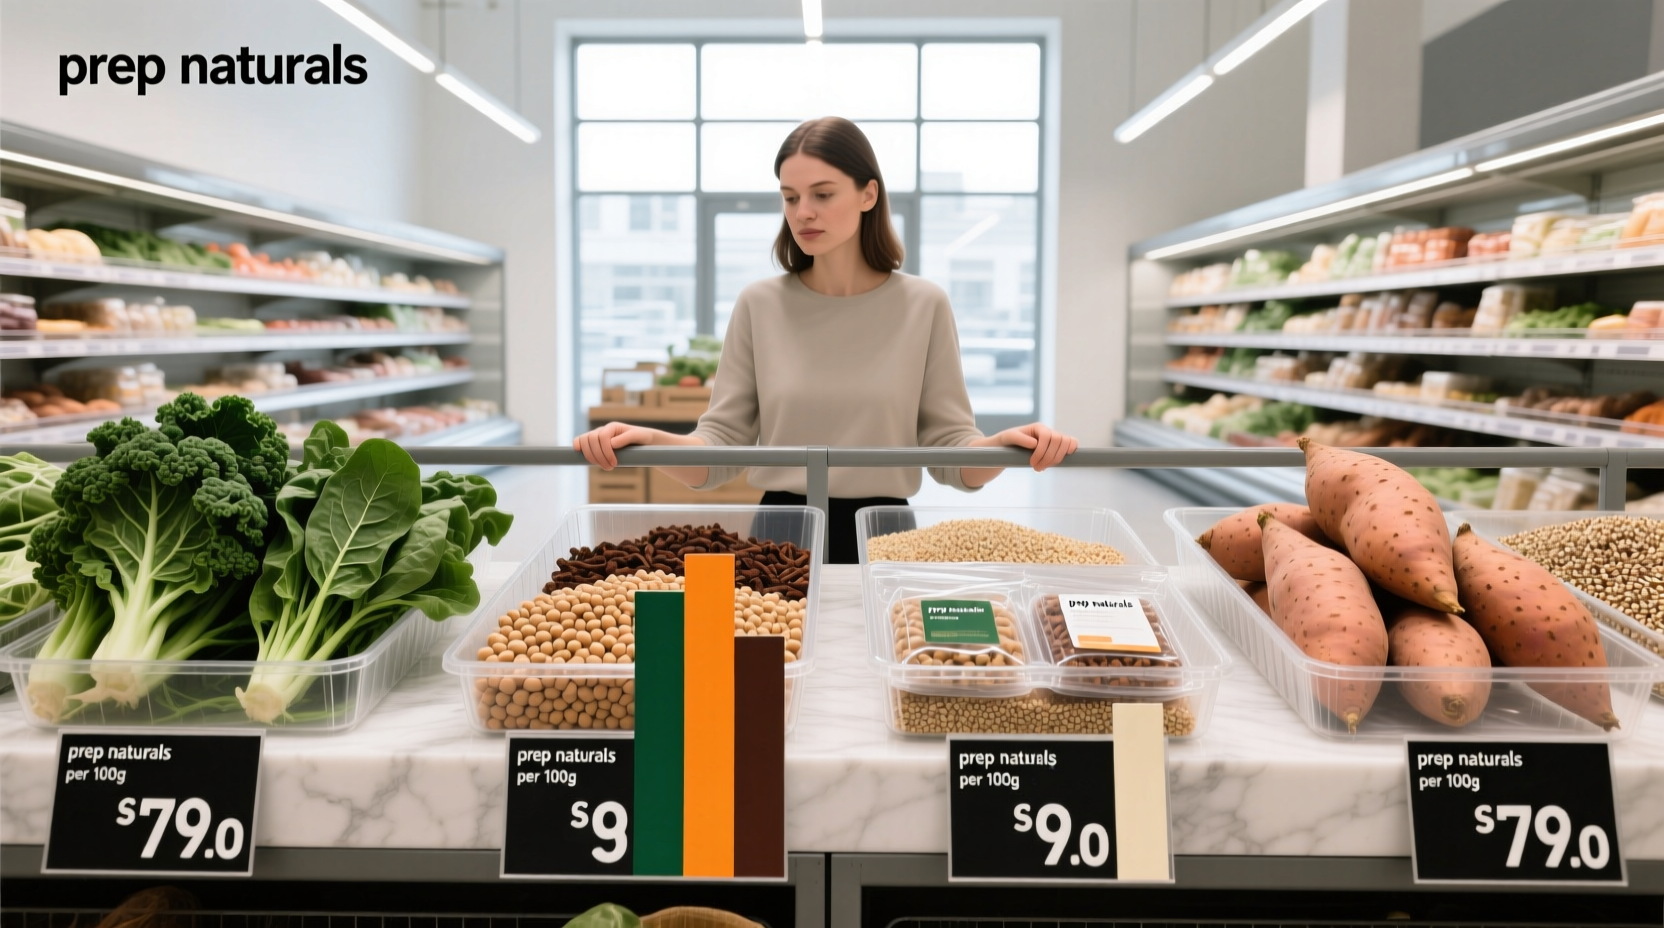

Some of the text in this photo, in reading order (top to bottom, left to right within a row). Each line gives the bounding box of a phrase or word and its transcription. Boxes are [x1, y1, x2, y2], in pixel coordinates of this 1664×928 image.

[68, 744, 171, 763] prep naturals
[517, 748, 616, 766] prep naturals
[960, 750, 1057, 769] prep naturals
[1418, 750, 1522, 770] prep naturals
[66, 766, 126, 785] per 100g
[517, 769, 576, 787] per 100g
[960, 772, 1019, 790] per 100g
[1420, 774, 1480, 792] per 100g
